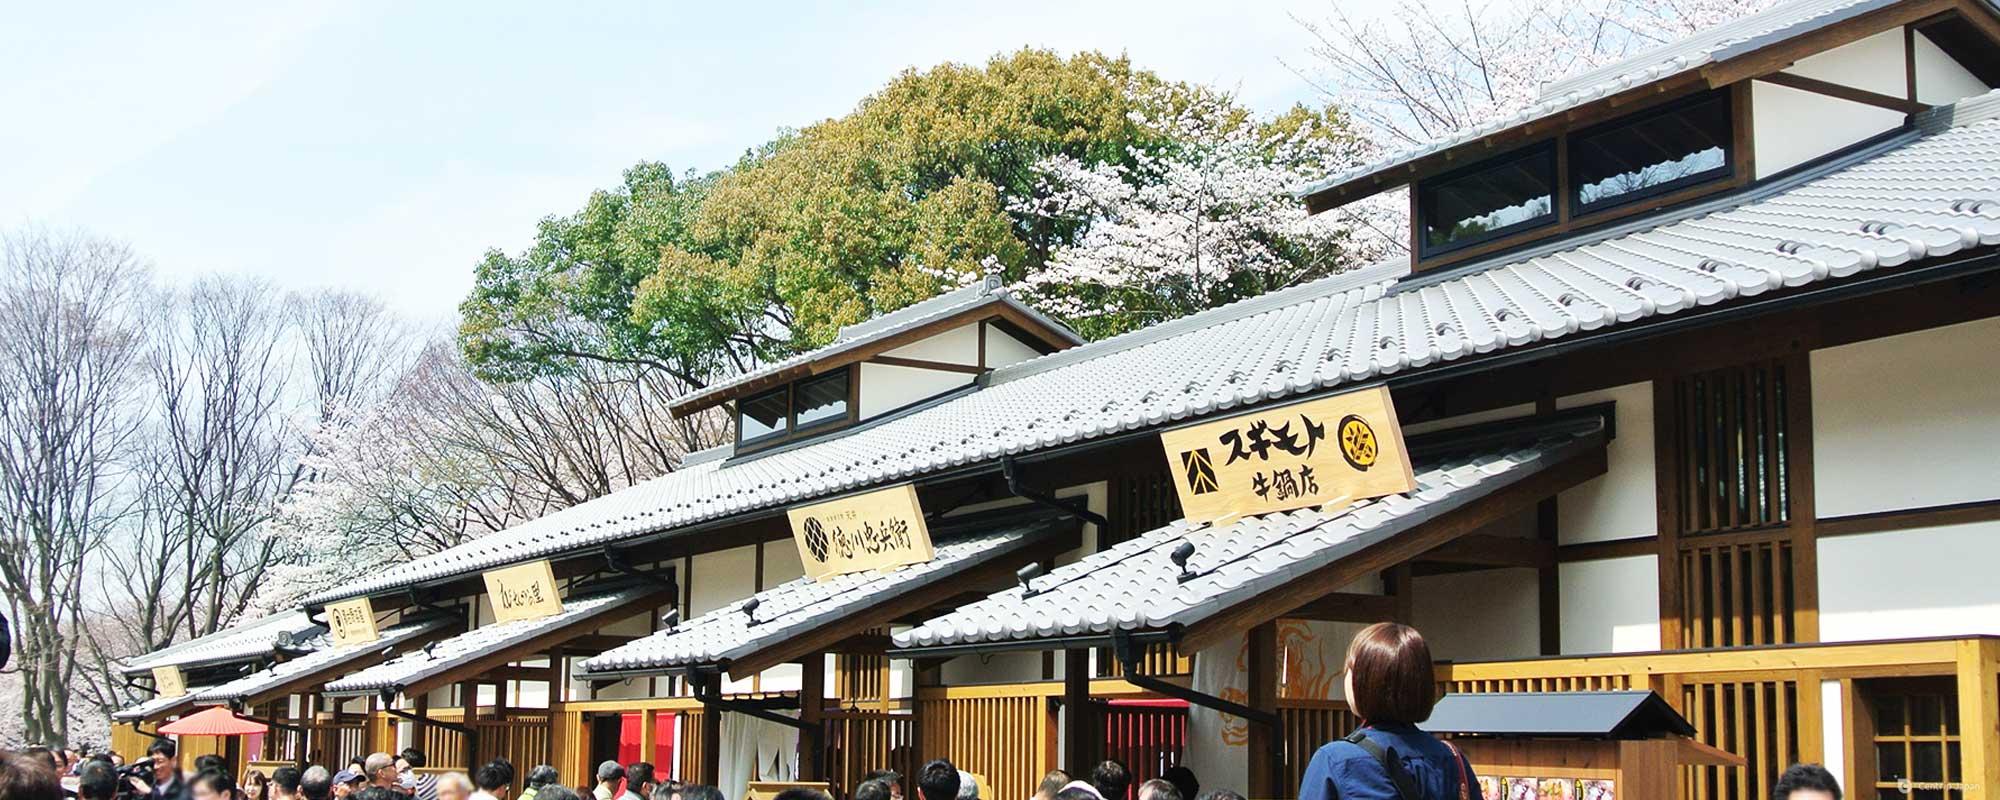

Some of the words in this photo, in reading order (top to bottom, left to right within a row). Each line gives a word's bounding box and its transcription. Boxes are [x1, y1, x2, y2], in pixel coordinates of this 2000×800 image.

[1219, 414, 1325, 466] スギモト
[1252, 465, 1319, 502] 牛鍋店
